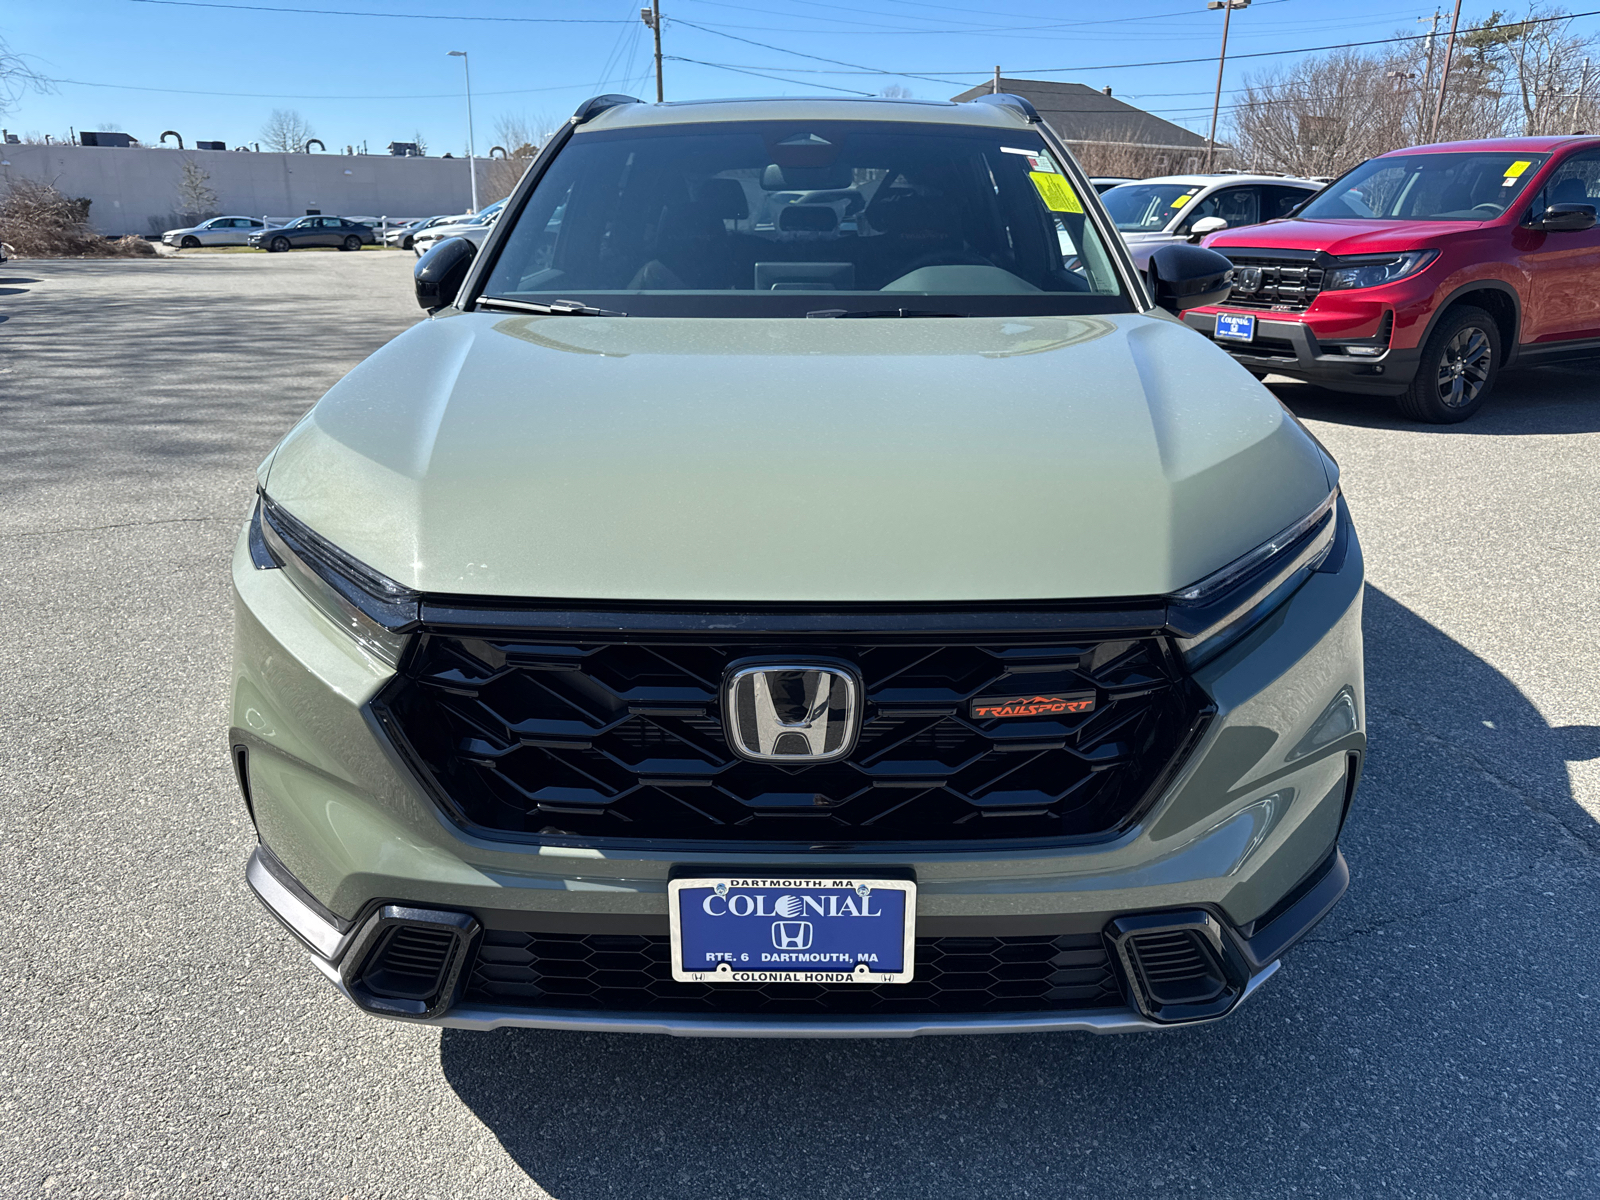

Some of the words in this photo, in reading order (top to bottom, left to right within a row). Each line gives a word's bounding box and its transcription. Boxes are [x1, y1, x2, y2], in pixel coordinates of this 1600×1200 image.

[976, 700, 1092, 717] TRAILSPORT
[832, 880, 854, 888] MA
[702, 894, 882, 918] COLONIAL
[706, 953, 736, 962] RTE.
[741, 953, 749, 961] 6
[761, 953, 853, 963] DARTMOUTH,
[857, 953, 878, 963] MA
[732, 972, 801, 982] COLONIAL
[804, 973, 854, 982] HONDA
